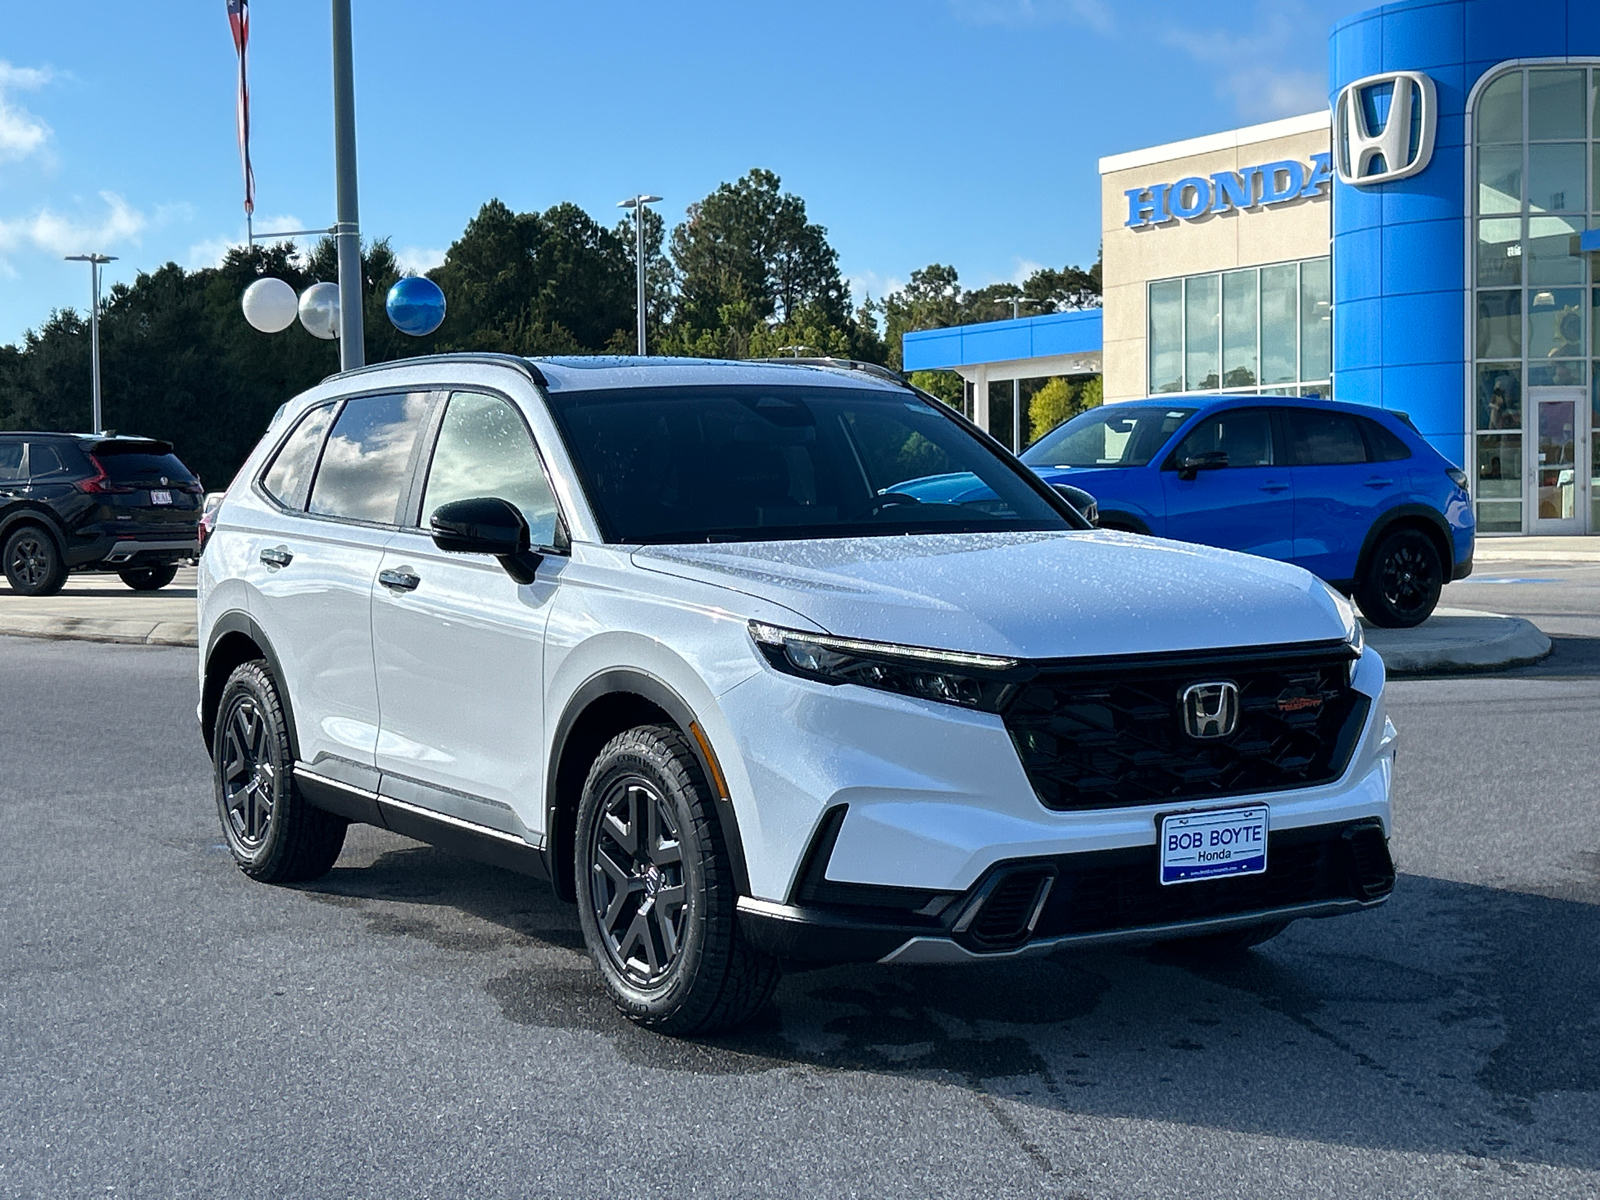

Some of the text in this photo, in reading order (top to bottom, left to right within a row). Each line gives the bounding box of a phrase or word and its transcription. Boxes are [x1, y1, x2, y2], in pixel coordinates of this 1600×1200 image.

[1124, 152, 1330, 227] HONDA
[1168, 825, 1262, 851] BOB BOYTE
[1198, 849, 1231, 862] Honda
